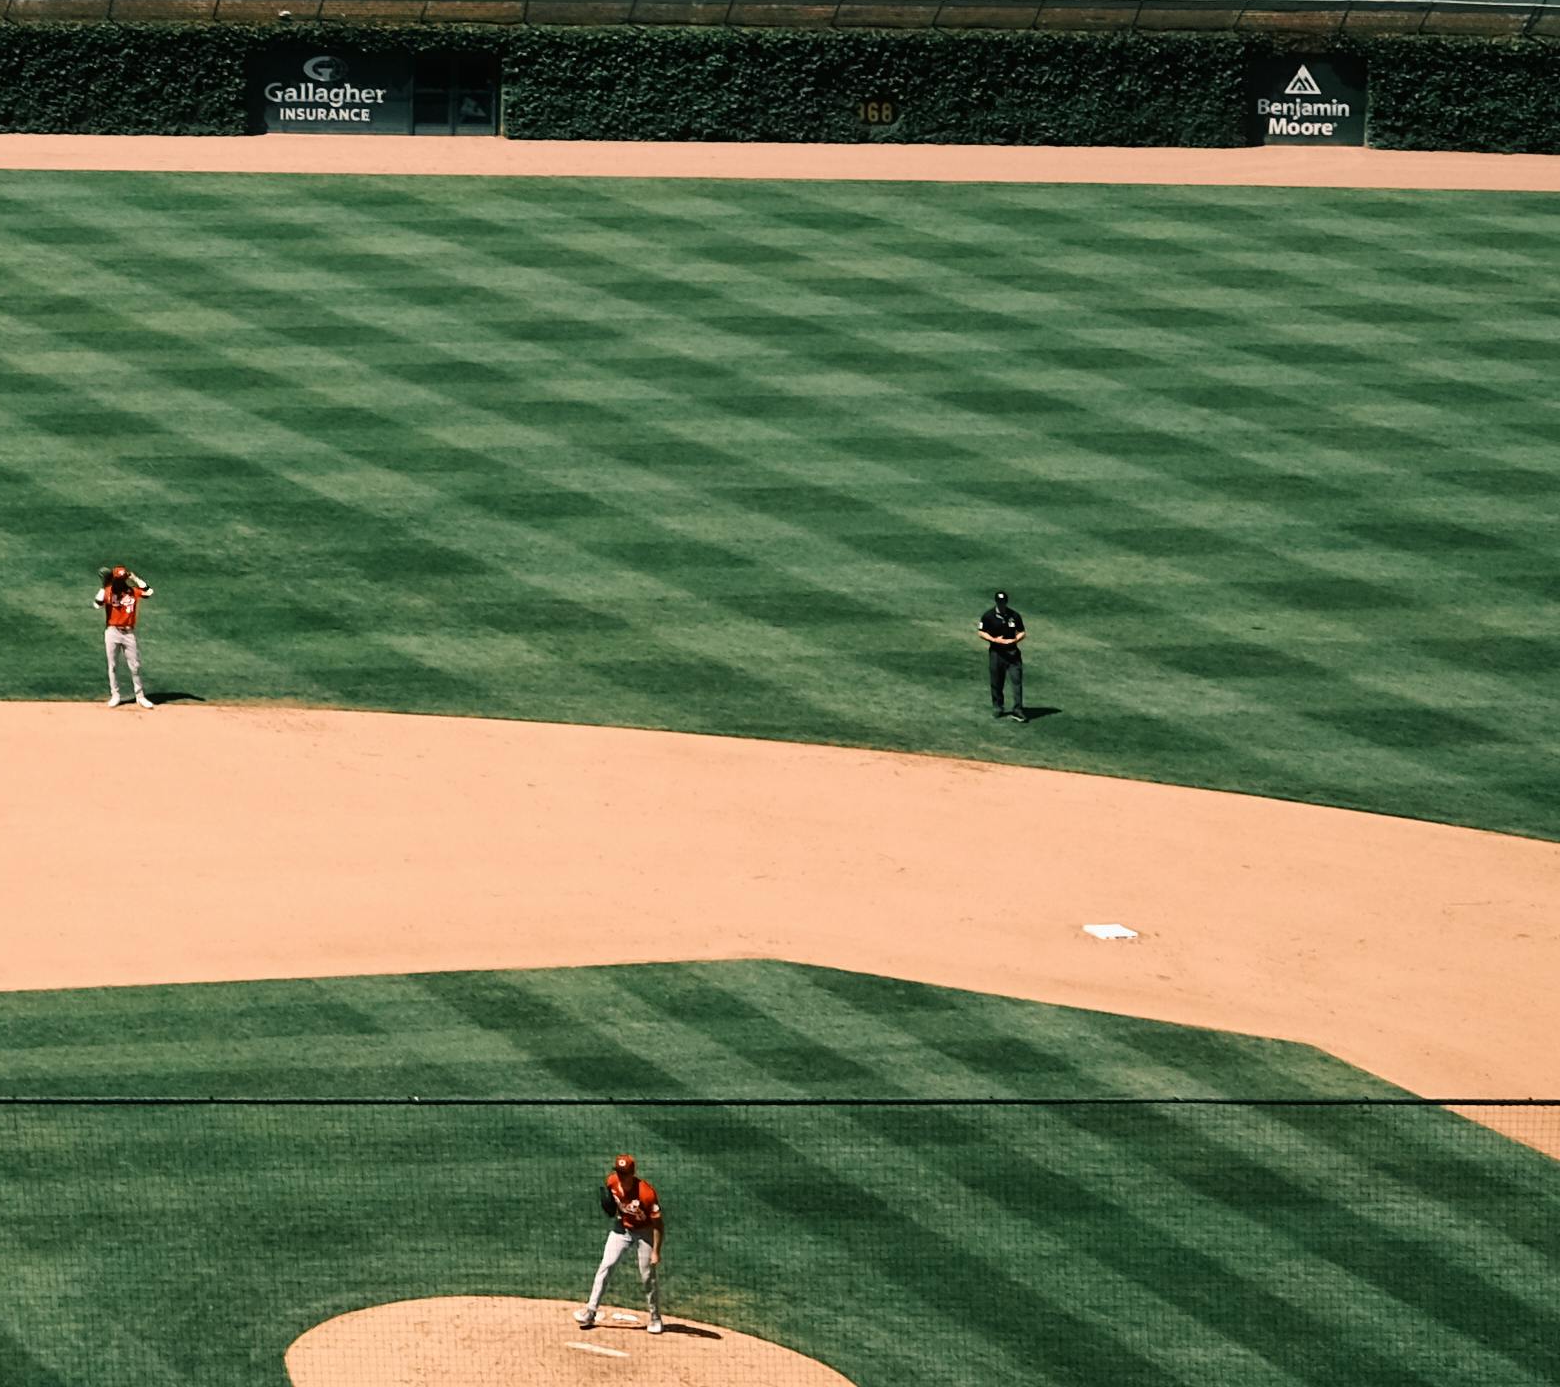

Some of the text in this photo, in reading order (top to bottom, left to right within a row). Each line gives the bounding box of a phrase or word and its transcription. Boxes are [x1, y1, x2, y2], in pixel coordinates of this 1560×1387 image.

[264, 82, 387, 107] Gallagher
[279, 108, 371, 122] INSURANCE
[1257, 98, 1350, 118] Benjamin
[1268, 117, 1333, 136] Moore
